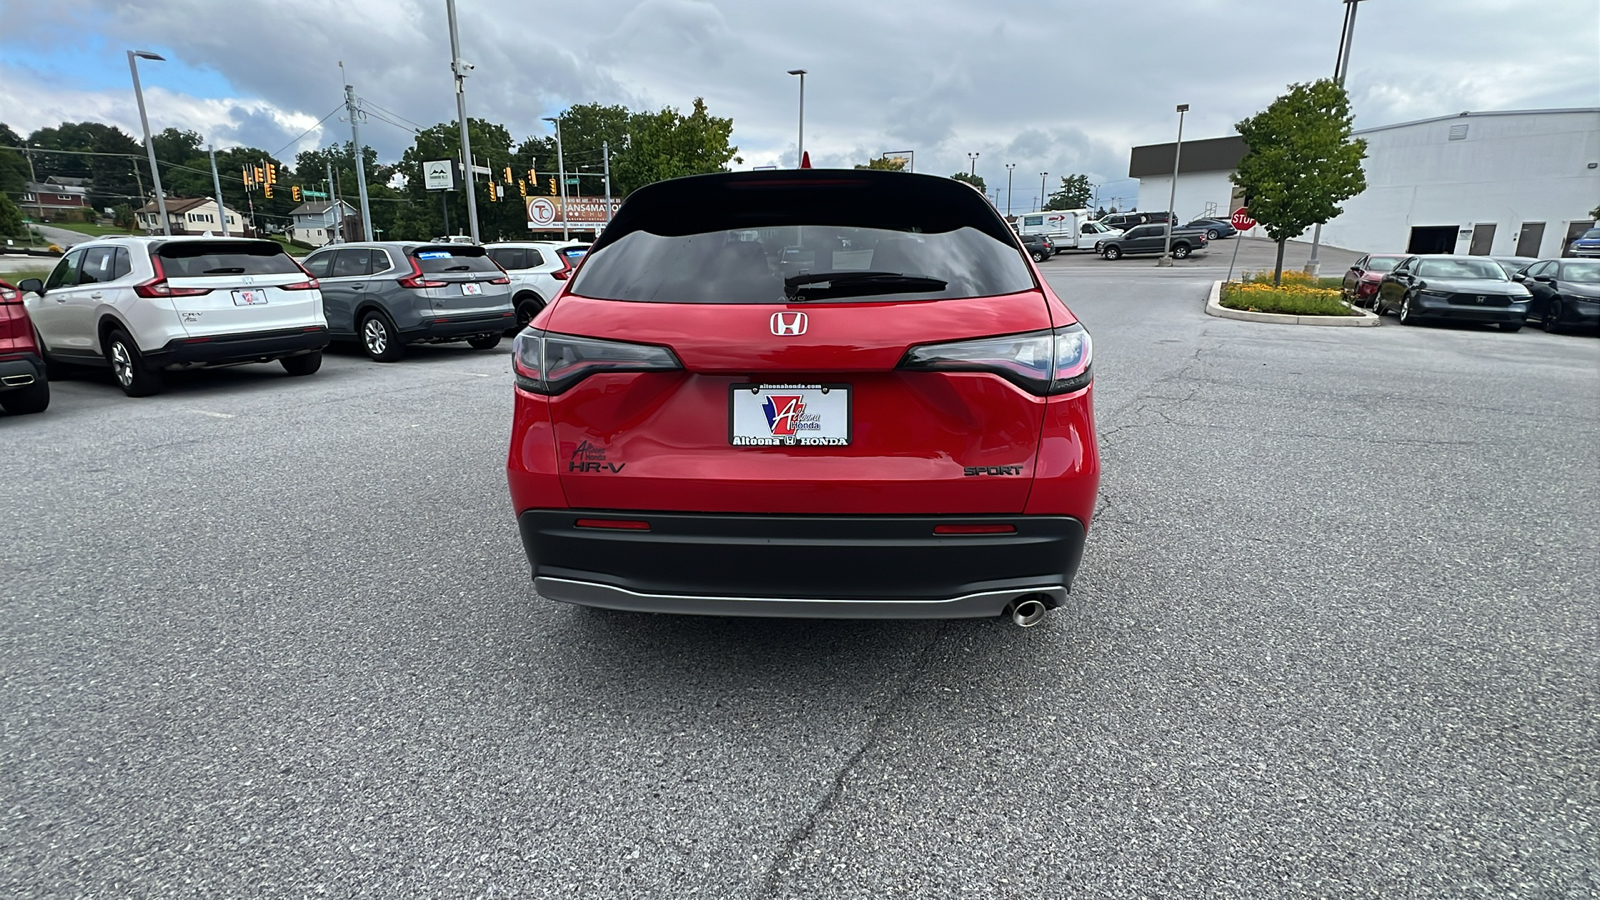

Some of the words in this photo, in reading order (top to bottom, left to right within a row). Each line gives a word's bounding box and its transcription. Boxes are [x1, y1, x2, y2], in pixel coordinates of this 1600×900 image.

[791, 421, 820, 430] Honda
[733, 436, 781, 446] Altoona
[800, 437, 848, 446] HONDA
[569, 461, 626, 473] HR-V
[963, 465, 1023, 476] SPORT
